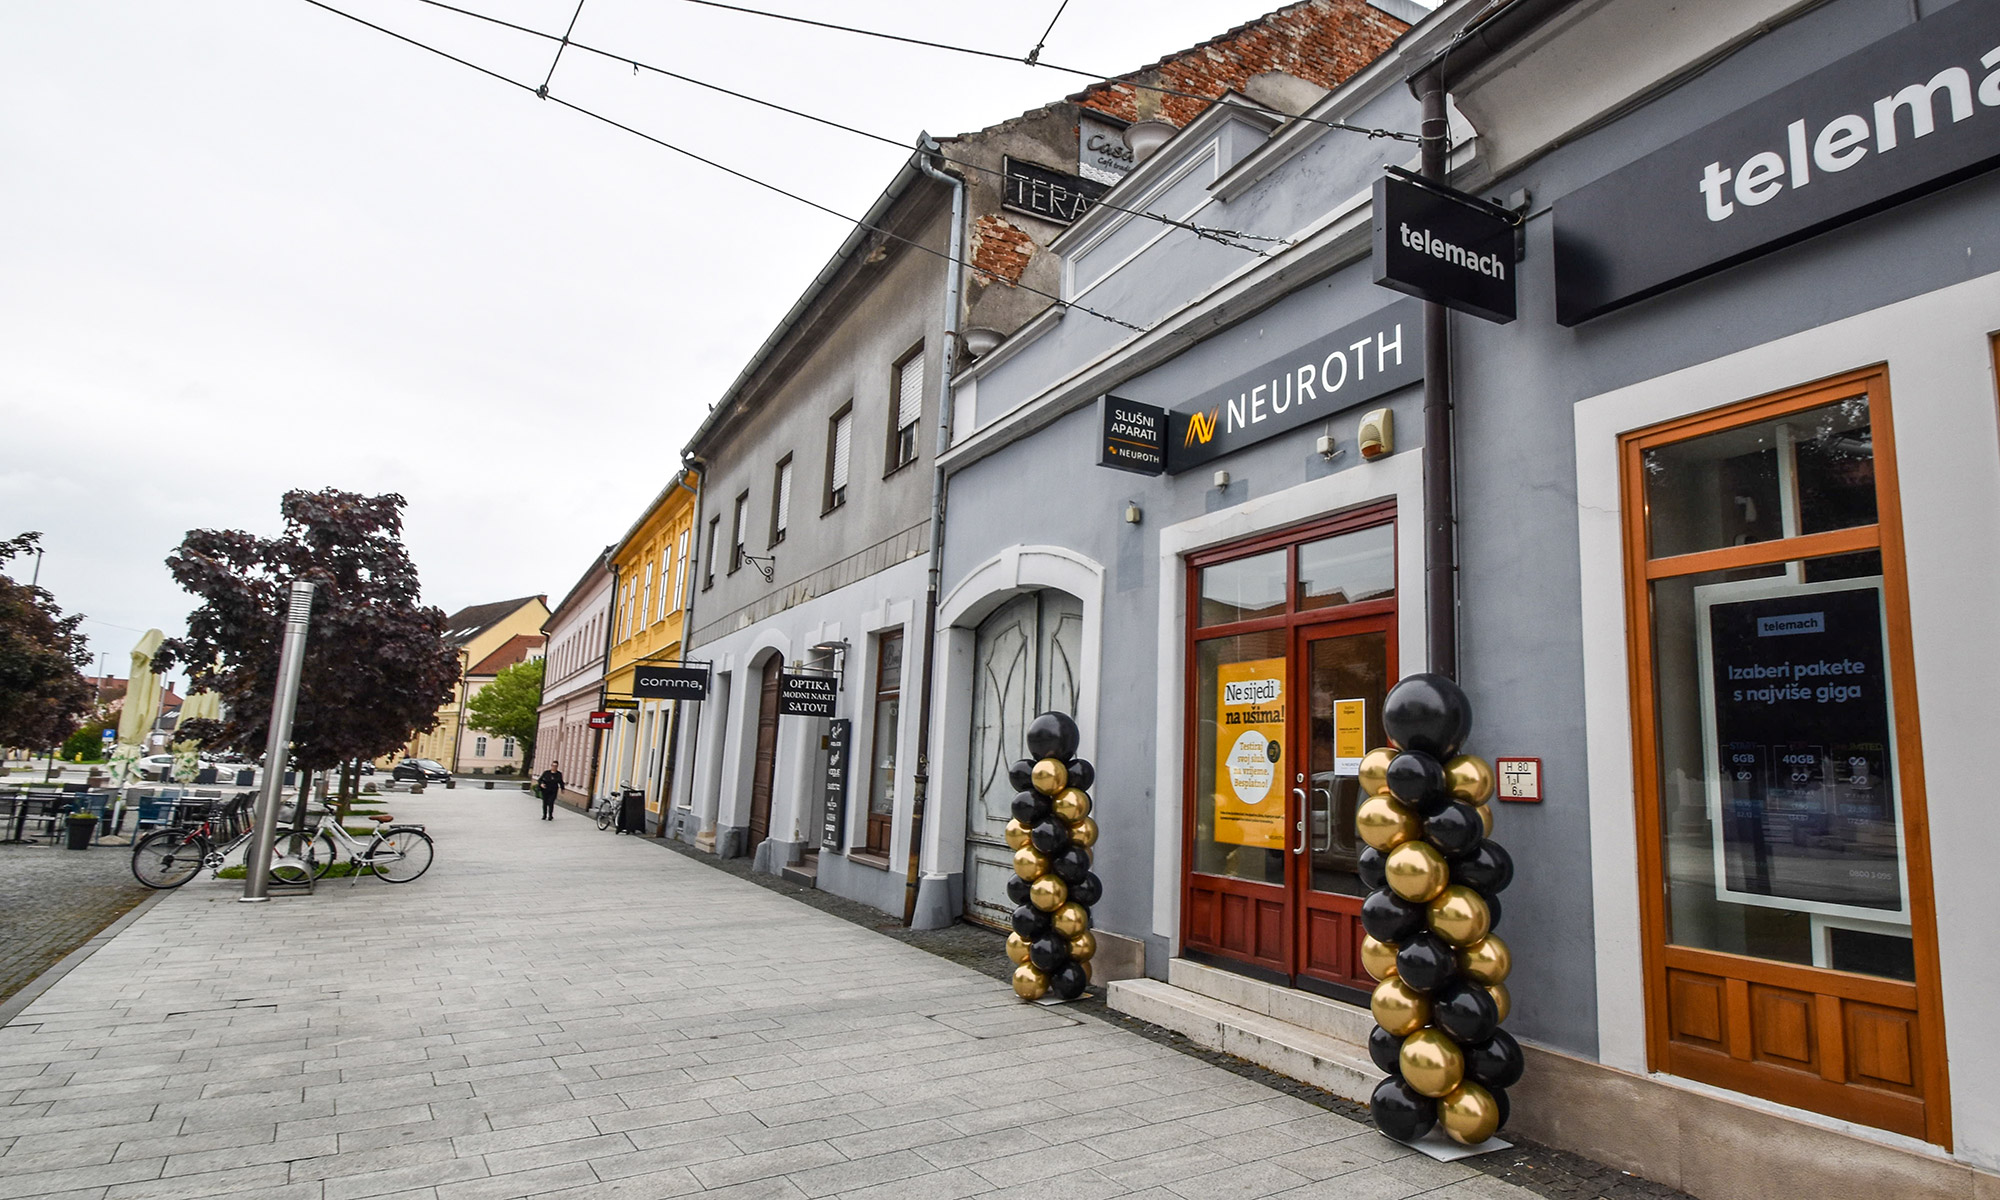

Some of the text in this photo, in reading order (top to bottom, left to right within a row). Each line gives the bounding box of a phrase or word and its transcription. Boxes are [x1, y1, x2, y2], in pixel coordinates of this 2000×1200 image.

[1087, 134, 1134, 163] Casa
[1400, 222, 1504, 280] telemach
[1227, 323, 1402, 433] NEUROTH
[1115, 409, 1154, 427] SLUŠNI
[1111, 423, 1156, 441] APARATI
[1119, 448, 1159, 463] NEUROTH
[1764, 618, 1818, 632] telemach
[1728, 659, 1865, 681] Izaberi pakete
[640, 678, 703, 691] comma,
[790, 679, 831, 690] OPTIKA
[783, 691, 836, 701] MODNI NAKIT
[1226, 681, 1275, 705] Ne sijedi
[1733, 682, 1861, 705] s najviše giga
[789, 702, 828, 713] SATOVI
[1226, 705, 1285, 724] na ušima!
[1239, 742, 1264, 752] Testiraj
[1732, 753, 1755, 763] 6GB
[1782, 754, 1815, 764] 40GB
[1507, 762, 1528, 771] H 80
